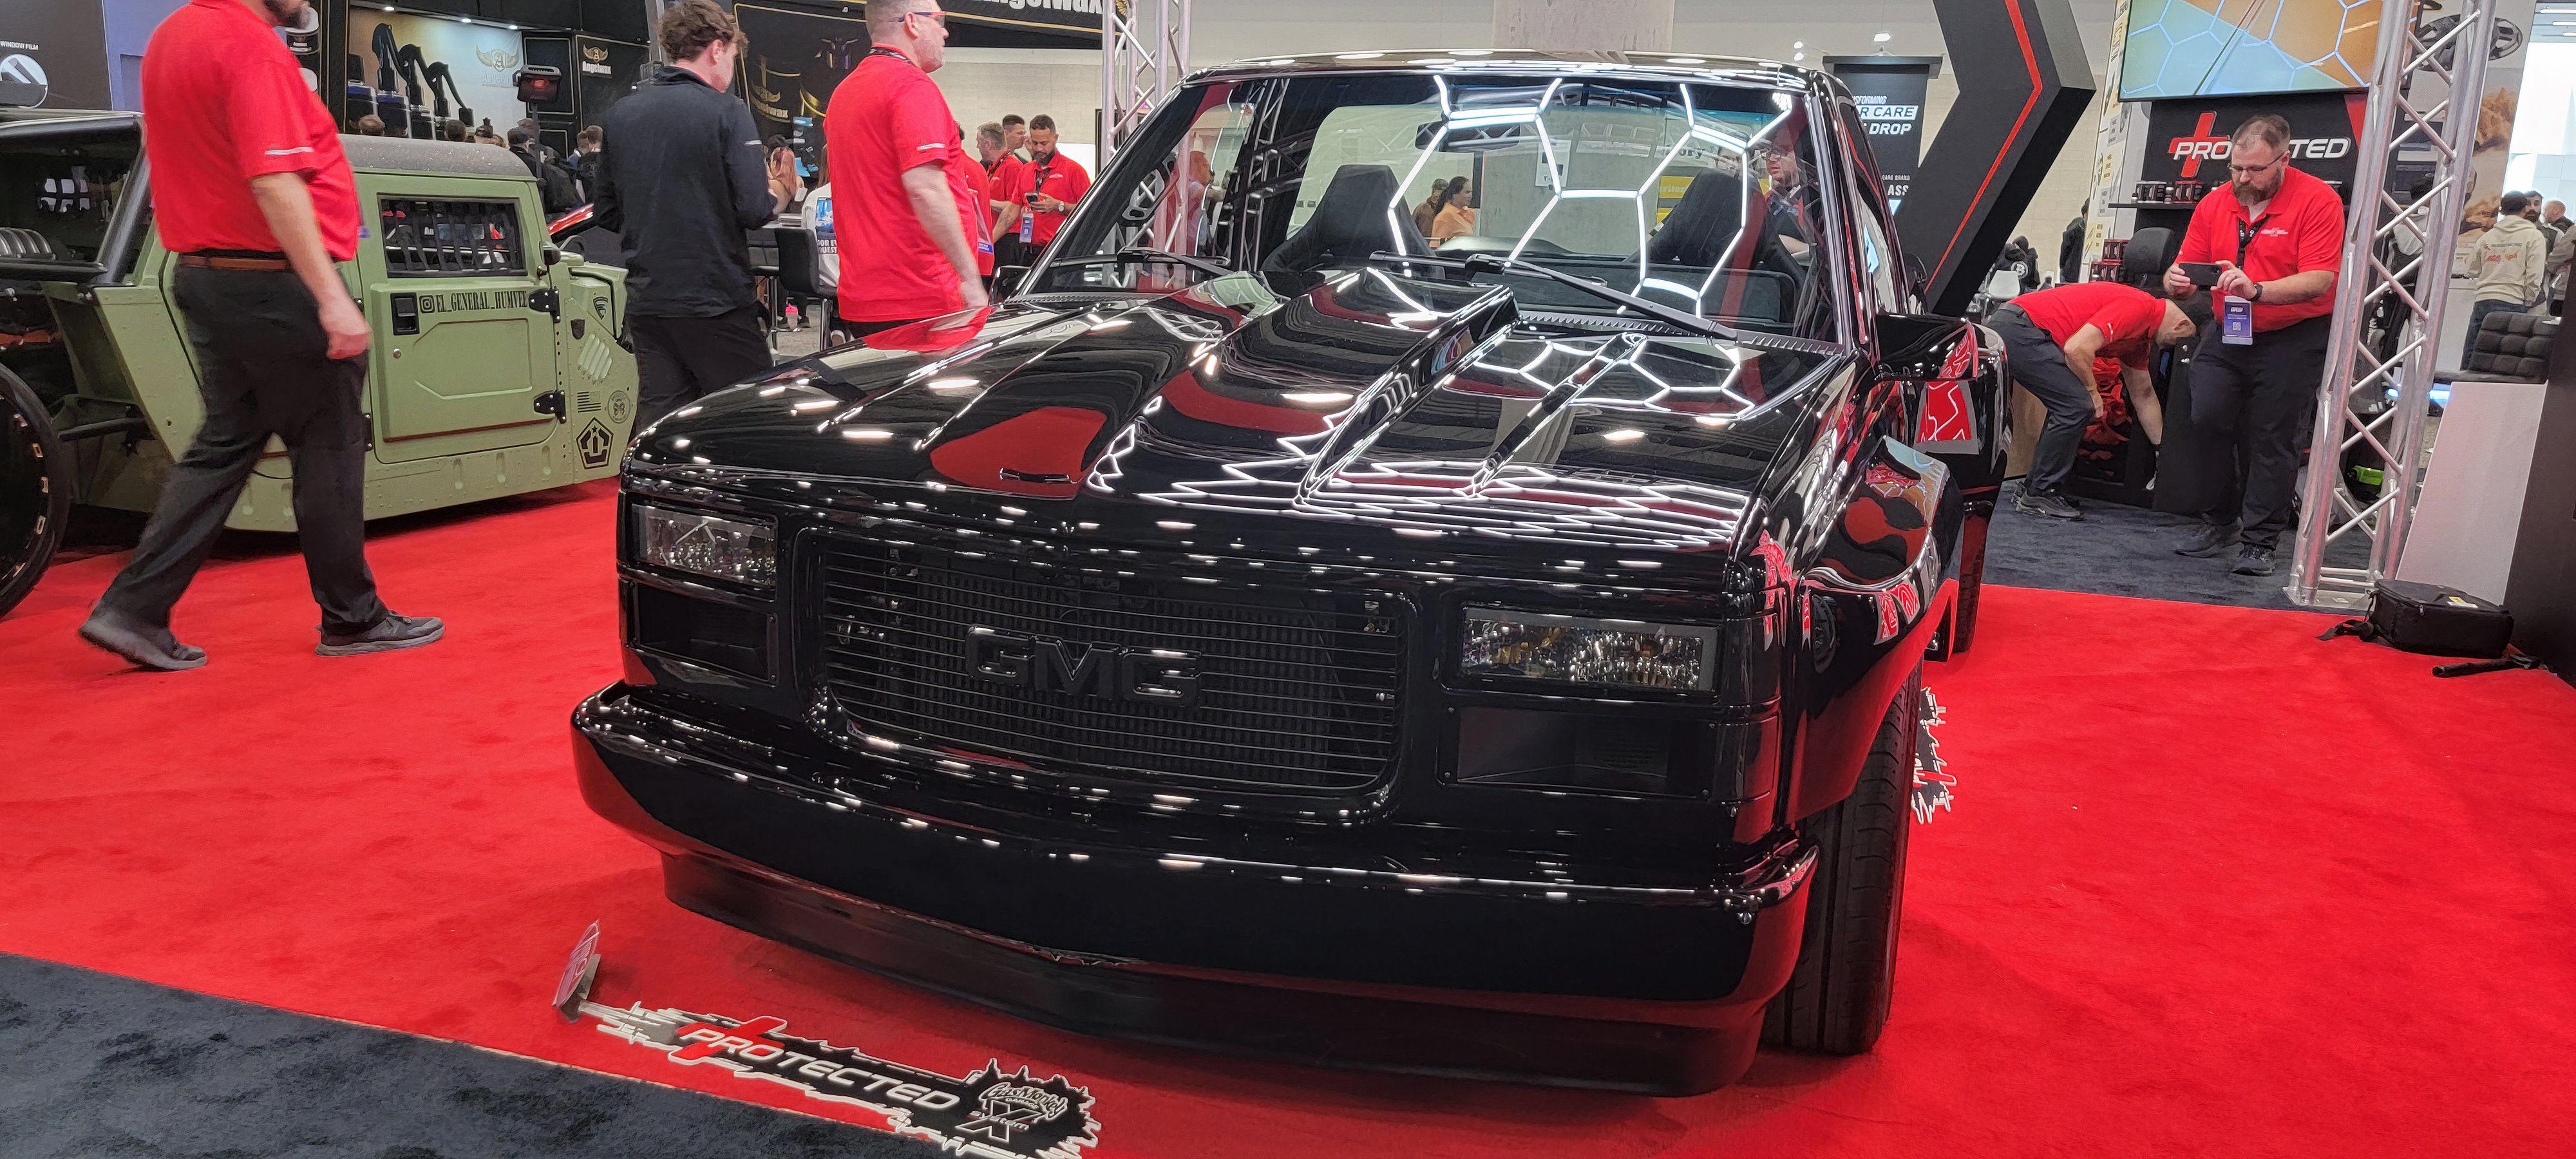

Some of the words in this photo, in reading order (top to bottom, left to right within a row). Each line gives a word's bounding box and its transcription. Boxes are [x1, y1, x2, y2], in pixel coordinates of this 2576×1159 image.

[1, 41, 24, 49] WINDOW
[1873, 107, 1915, 117] CARE
[1869, 122, 1912, 135] DROP
[2173, 137, 2351, 160] PROTED
[436, 291, 527, 313] EL_GENERAL_HUMVEE
[965, 624, 1202, 708] GMC
[679, 1028, 961, 1109] PROTECTED
[1005, 1097, 1039, 1109] GARAGE
